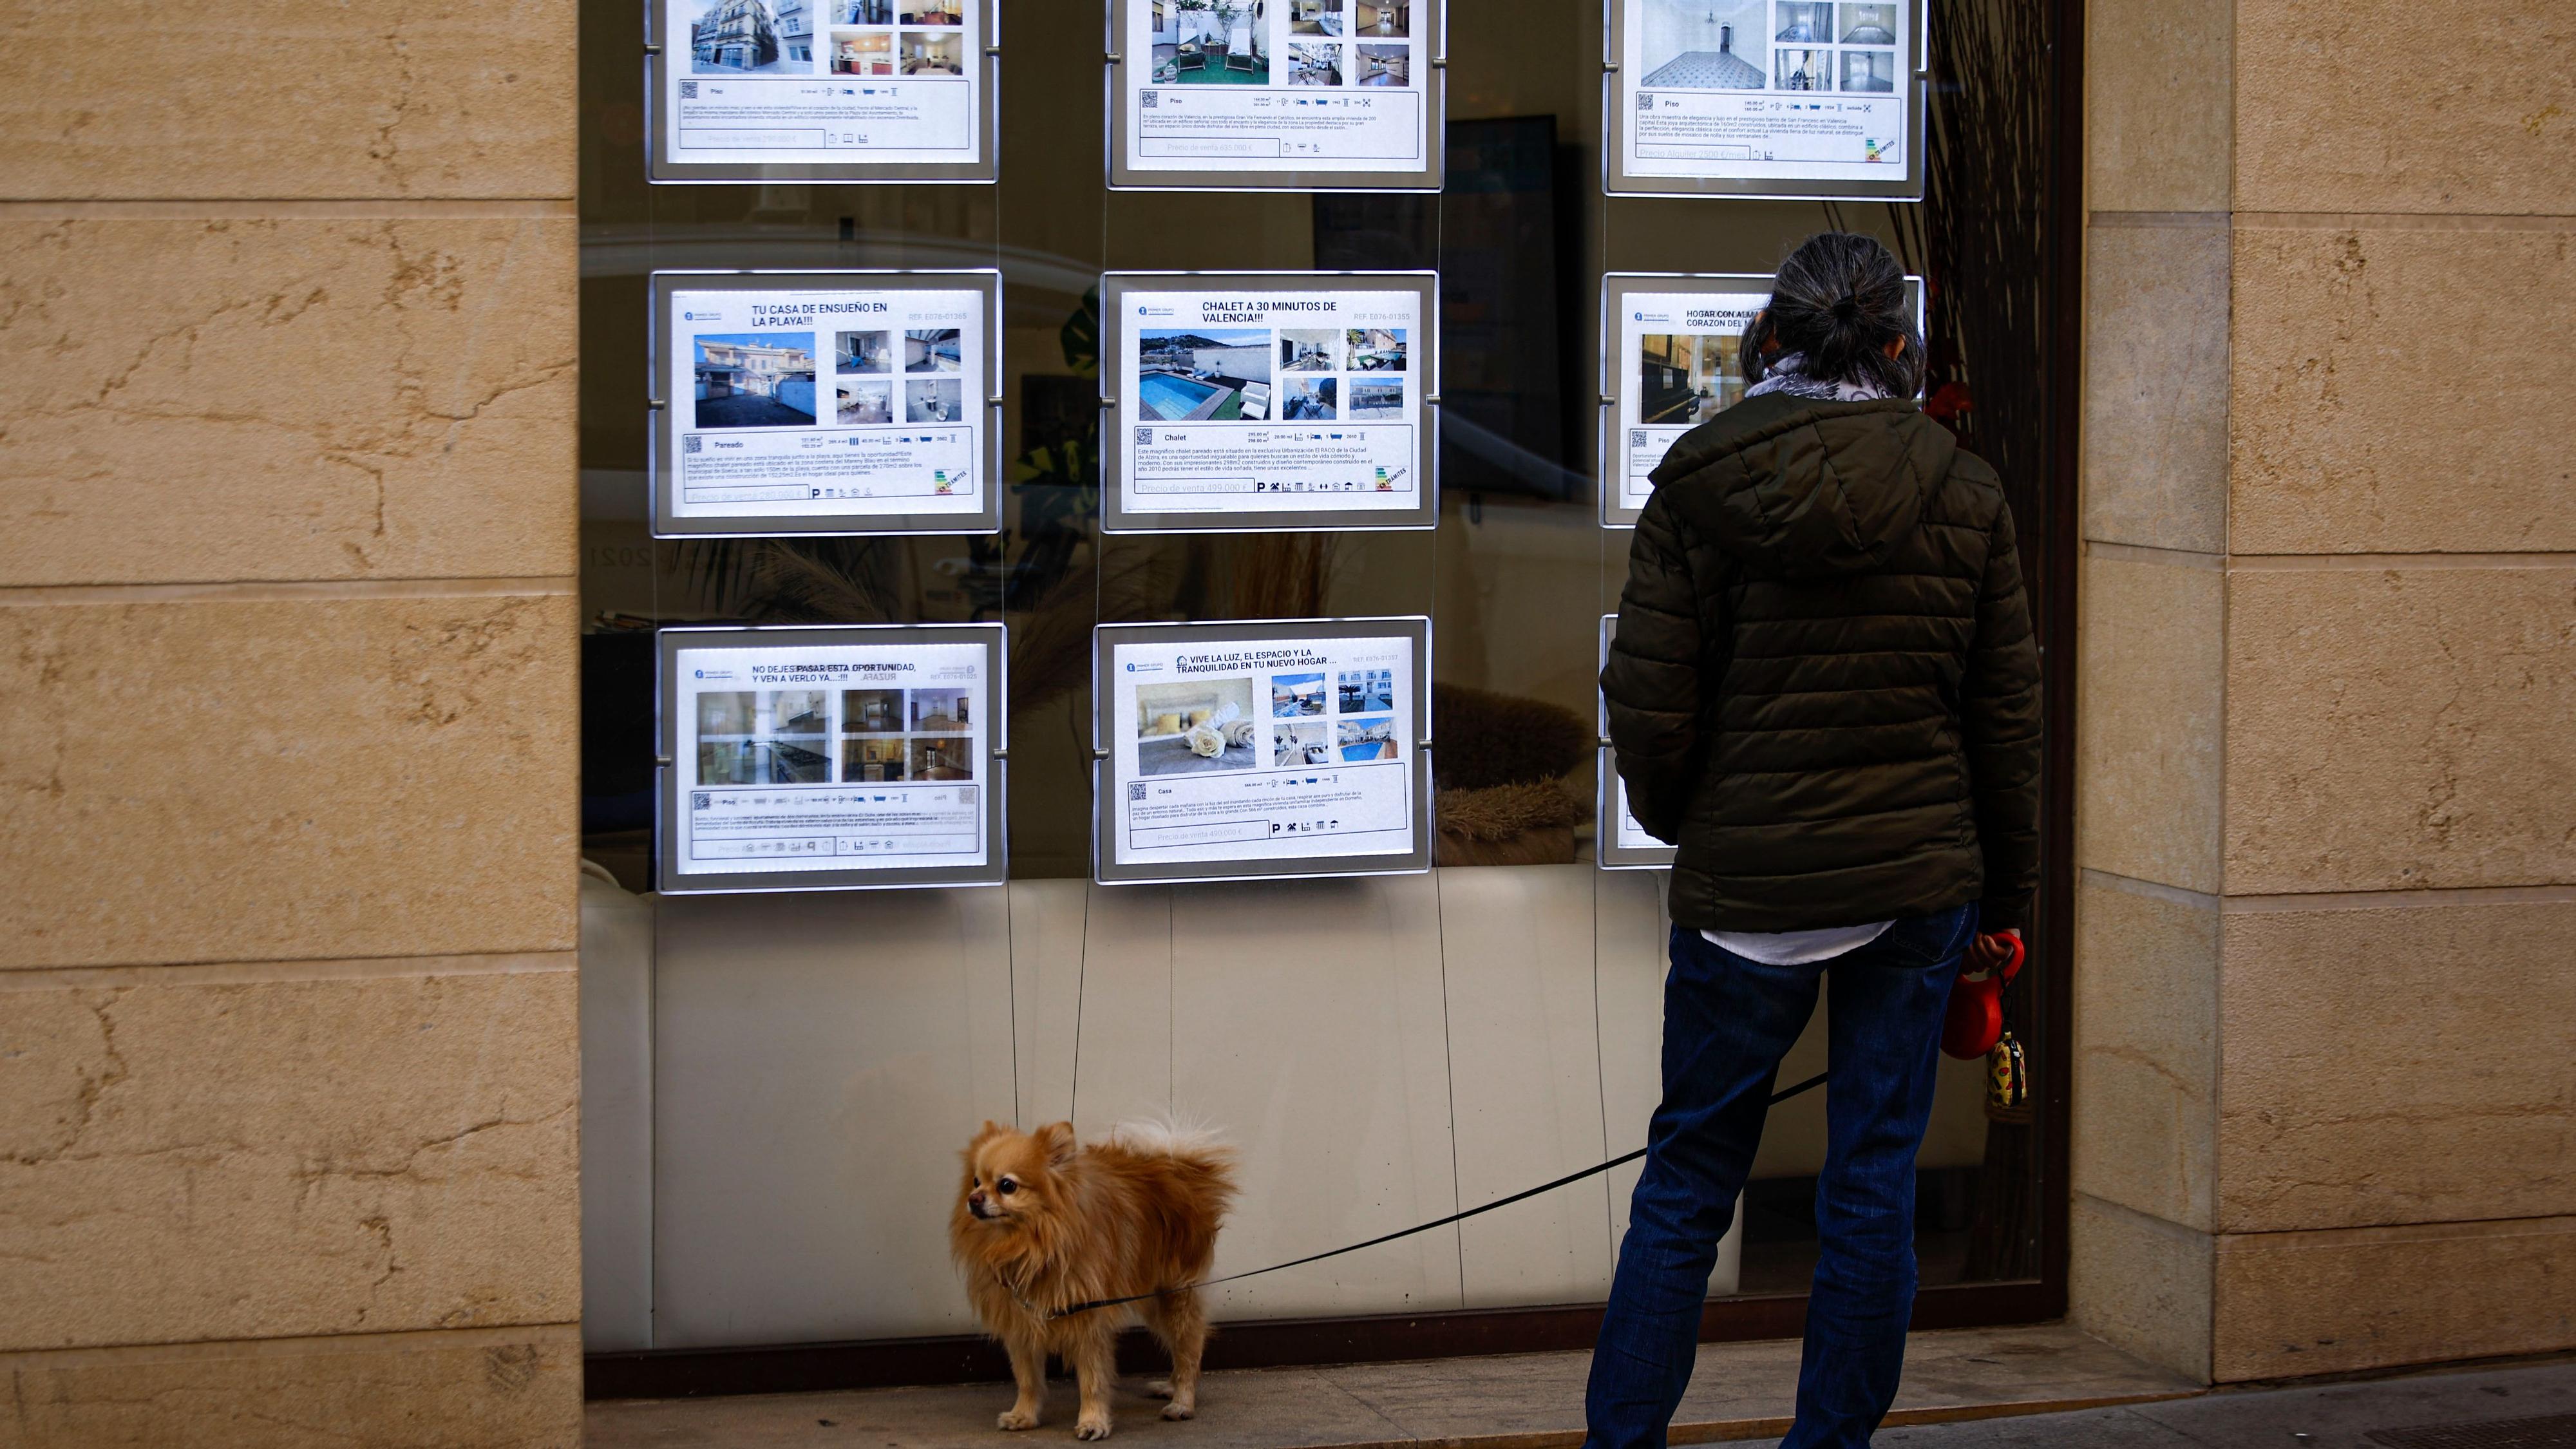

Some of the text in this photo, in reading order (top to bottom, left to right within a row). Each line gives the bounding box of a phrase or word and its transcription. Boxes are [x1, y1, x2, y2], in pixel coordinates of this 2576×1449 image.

[752, 301, 887, 314] TU CASA DE ENSUEÑO EN
[1202, 302, 1336, 311] CHALET A 30 MINUTOS DE
[752, 316, 813, 327] LA PLAYA!!!
[1202, 314, 1263, 322] VALENCIA!!!
[1208, 484, 1240, 492] 499.000
[1224, 654, 1242, 662] LUZ,
[1256, 650, 1291, 659] ESPACIO
[1176, 662, 1238, 674] TRANQUILIDAD
[1267, 659, 1295, 668] NUEVO
[1298, 657, 1327, 666] HOGAR
